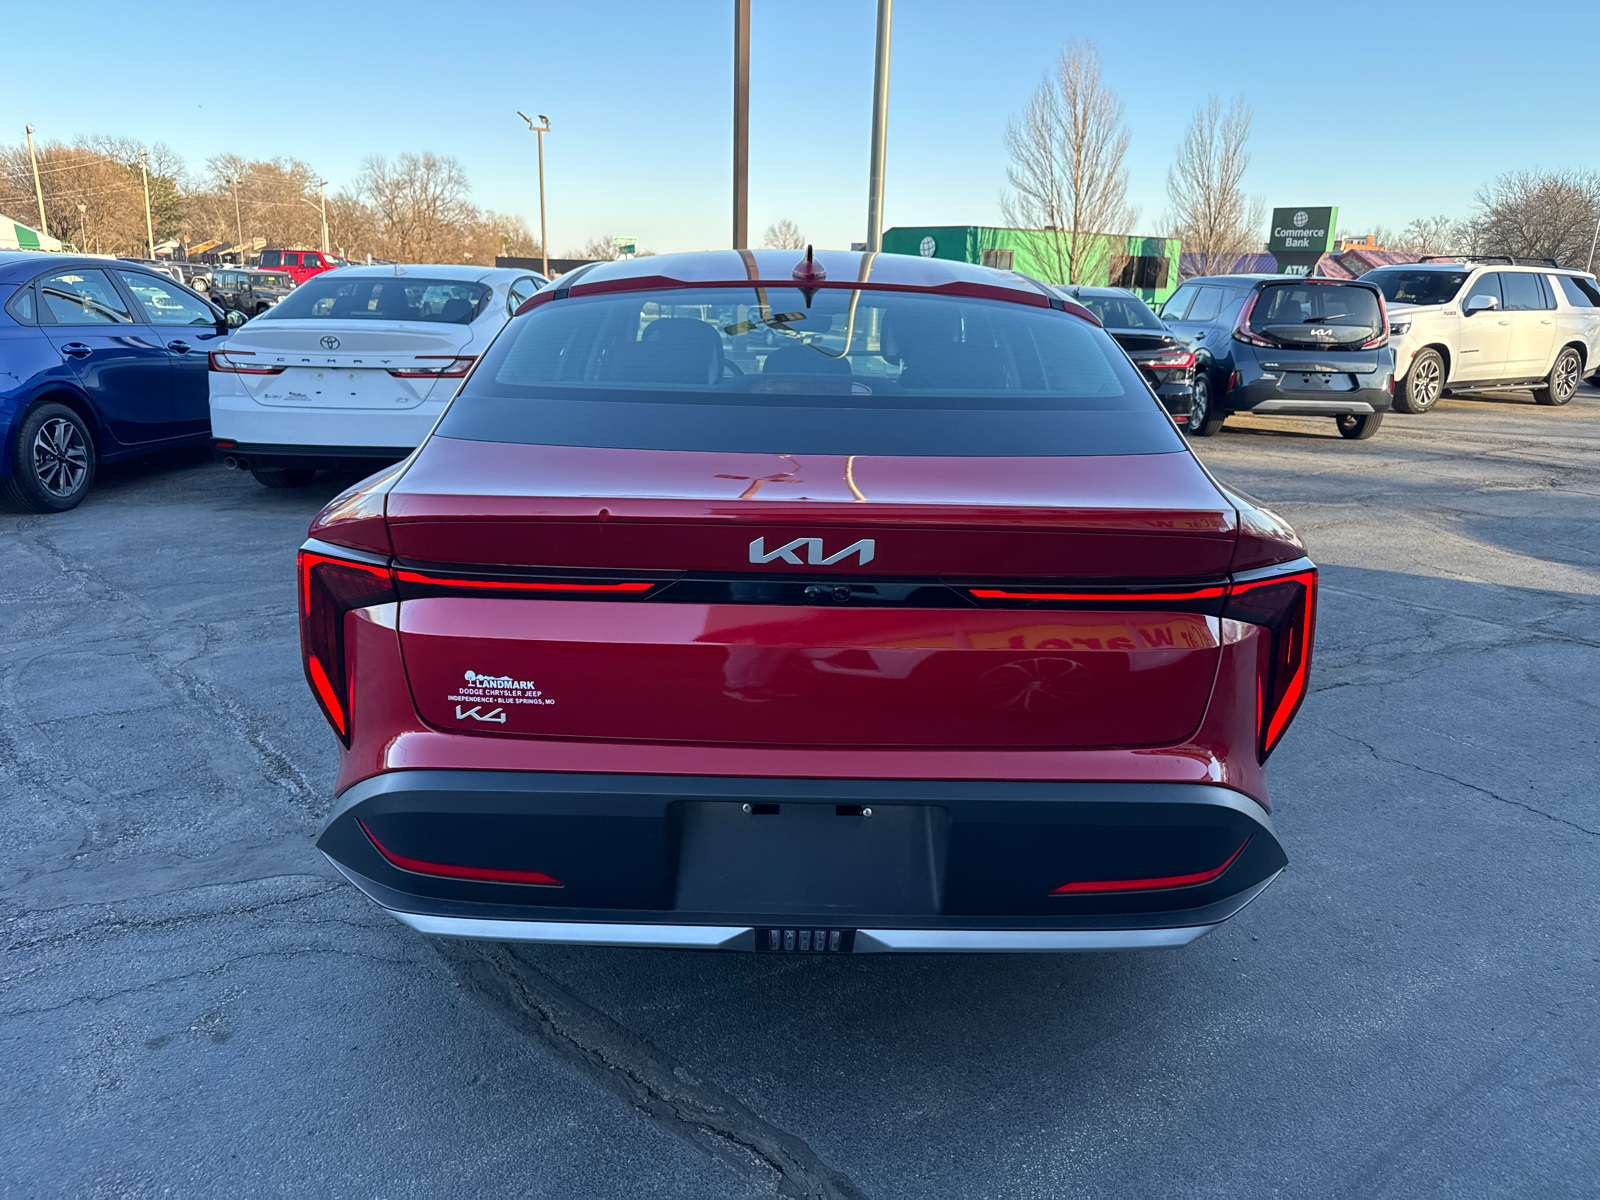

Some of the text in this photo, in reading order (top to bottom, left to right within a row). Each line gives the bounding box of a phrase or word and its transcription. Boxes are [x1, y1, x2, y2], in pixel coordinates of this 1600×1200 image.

[1274, 227, 1324, 237] Commerce
[1285, 238, 1309, 247] Bank
[1284, 265, 1308, 275] ATM
[749, 536, 875, 566] KIA
[476, 680, 535, 690] LANDMARK
[447, 695, 494, 703] INDEPENDENCE
[455, 705, 506, 724] K4
